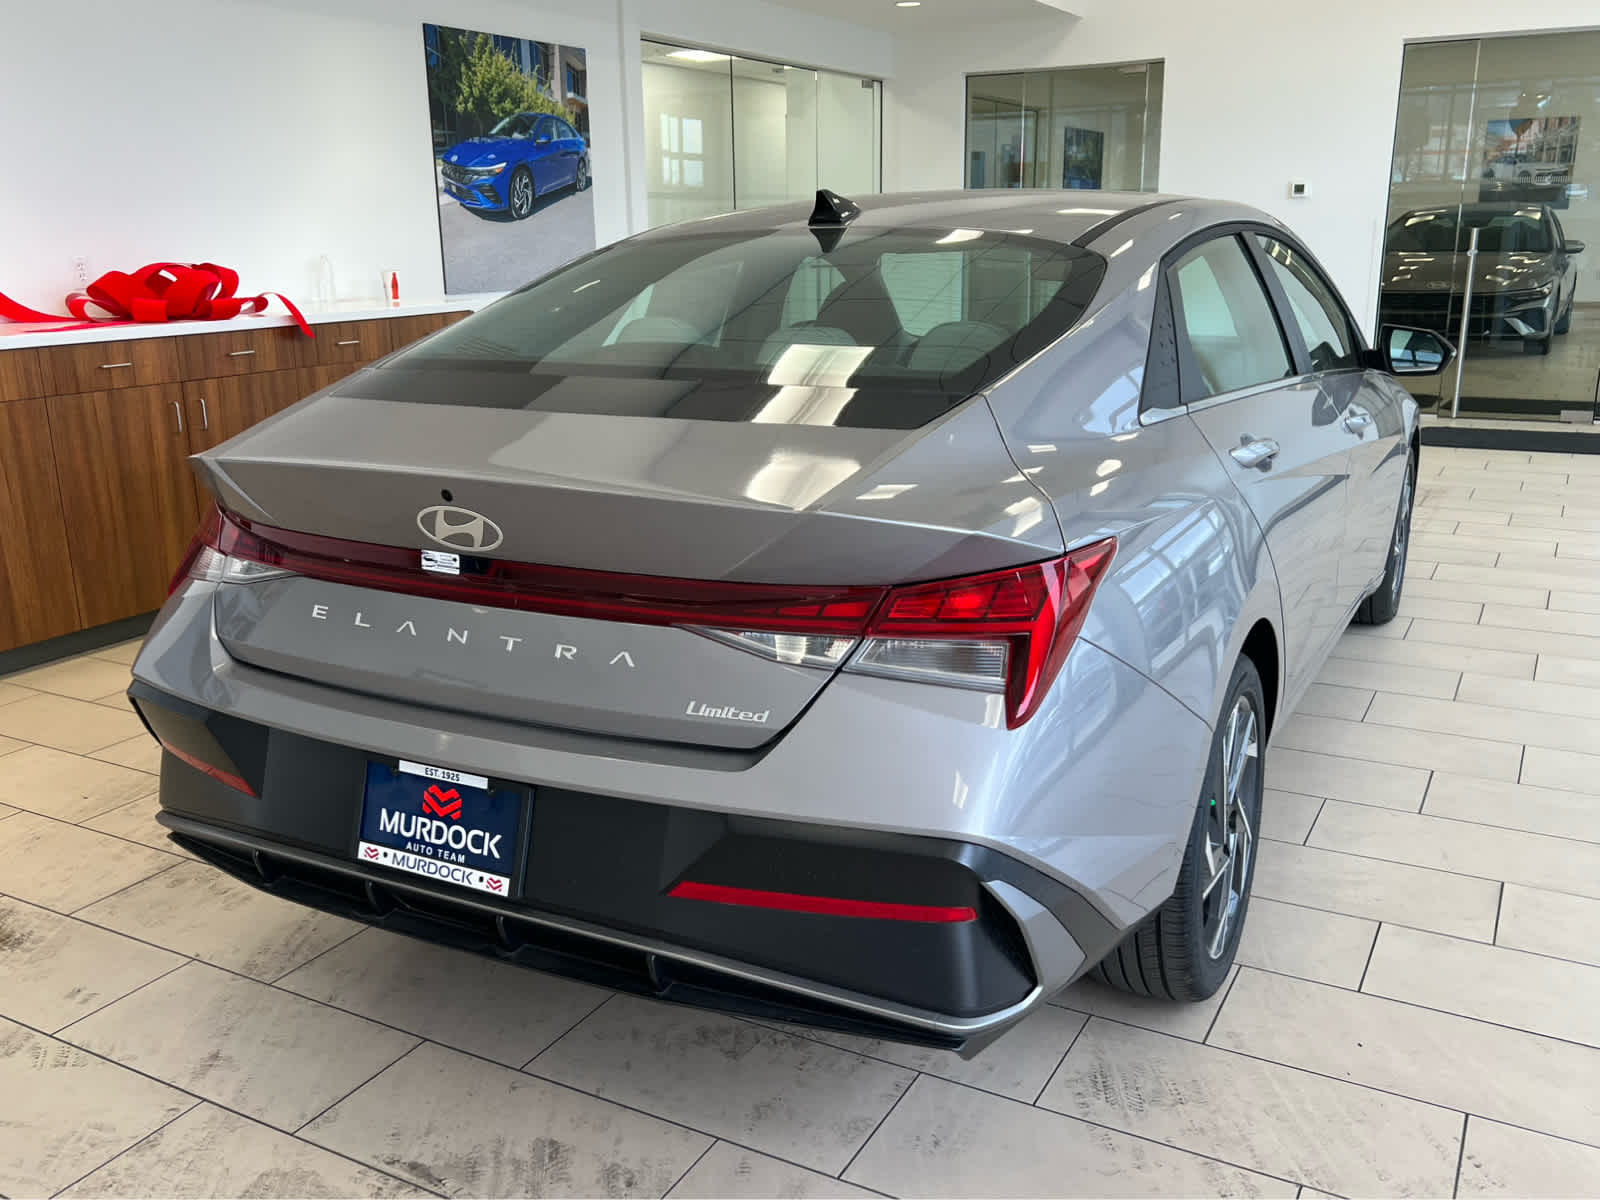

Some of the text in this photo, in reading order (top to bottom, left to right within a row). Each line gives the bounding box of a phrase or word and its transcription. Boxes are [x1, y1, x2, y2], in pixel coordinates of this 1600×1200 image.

[311, 604, 636, 668] ELANTRA
[686, 701, 769, 724] Limited
[424, 767, 460, 782] EST. 1925
[379, 807, 502, 859] MURDOCK
[405, 842, 466, 864] AUTO TEAM
[391, 852, 474, 886] MURDOCK
